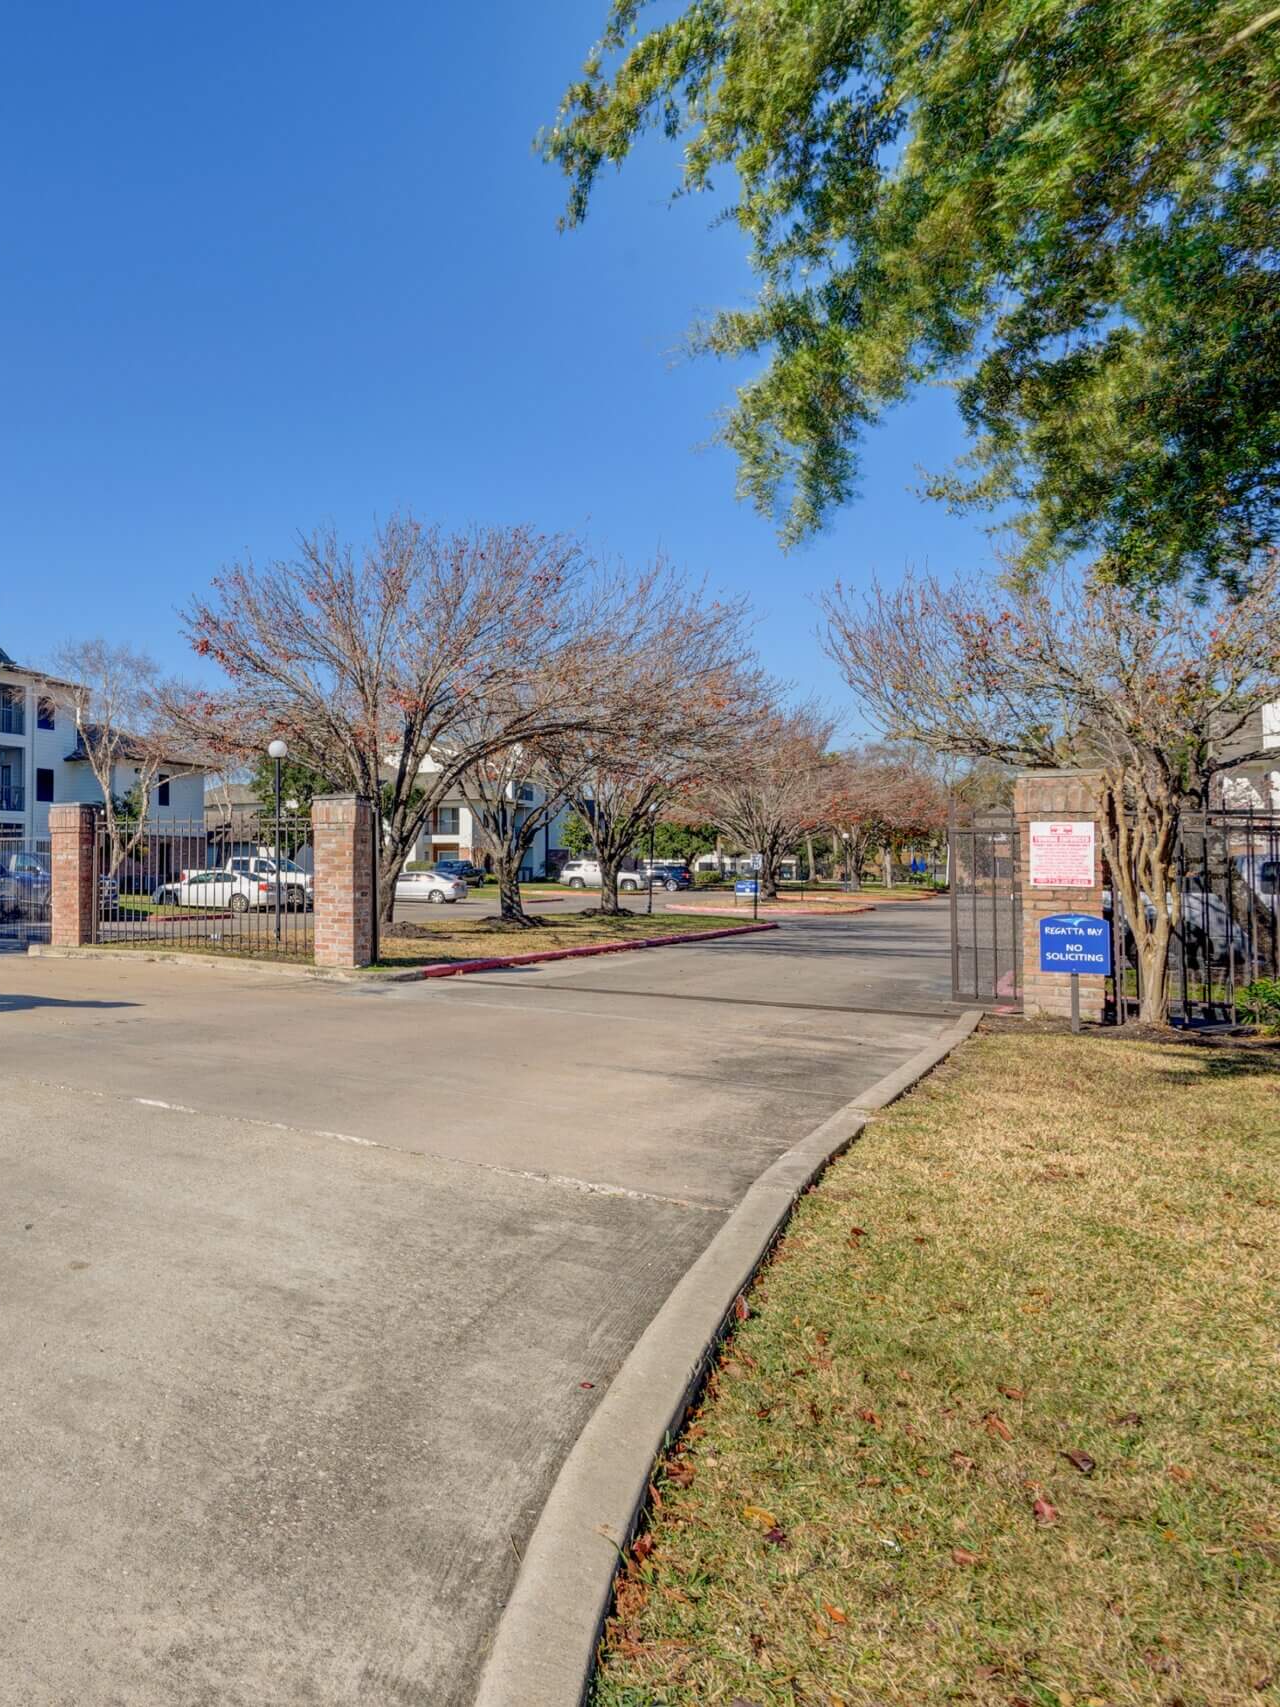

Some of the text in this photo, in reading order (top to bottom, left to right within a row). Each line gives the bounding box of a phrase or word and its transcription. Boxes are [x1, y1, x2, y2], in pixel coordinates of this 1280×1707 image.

[1045, 927, 1103, 936] REGATTA BAY
[1066, 944, 1083, 952] NO
[1046, 952, 1104, 962] SOLICITING
